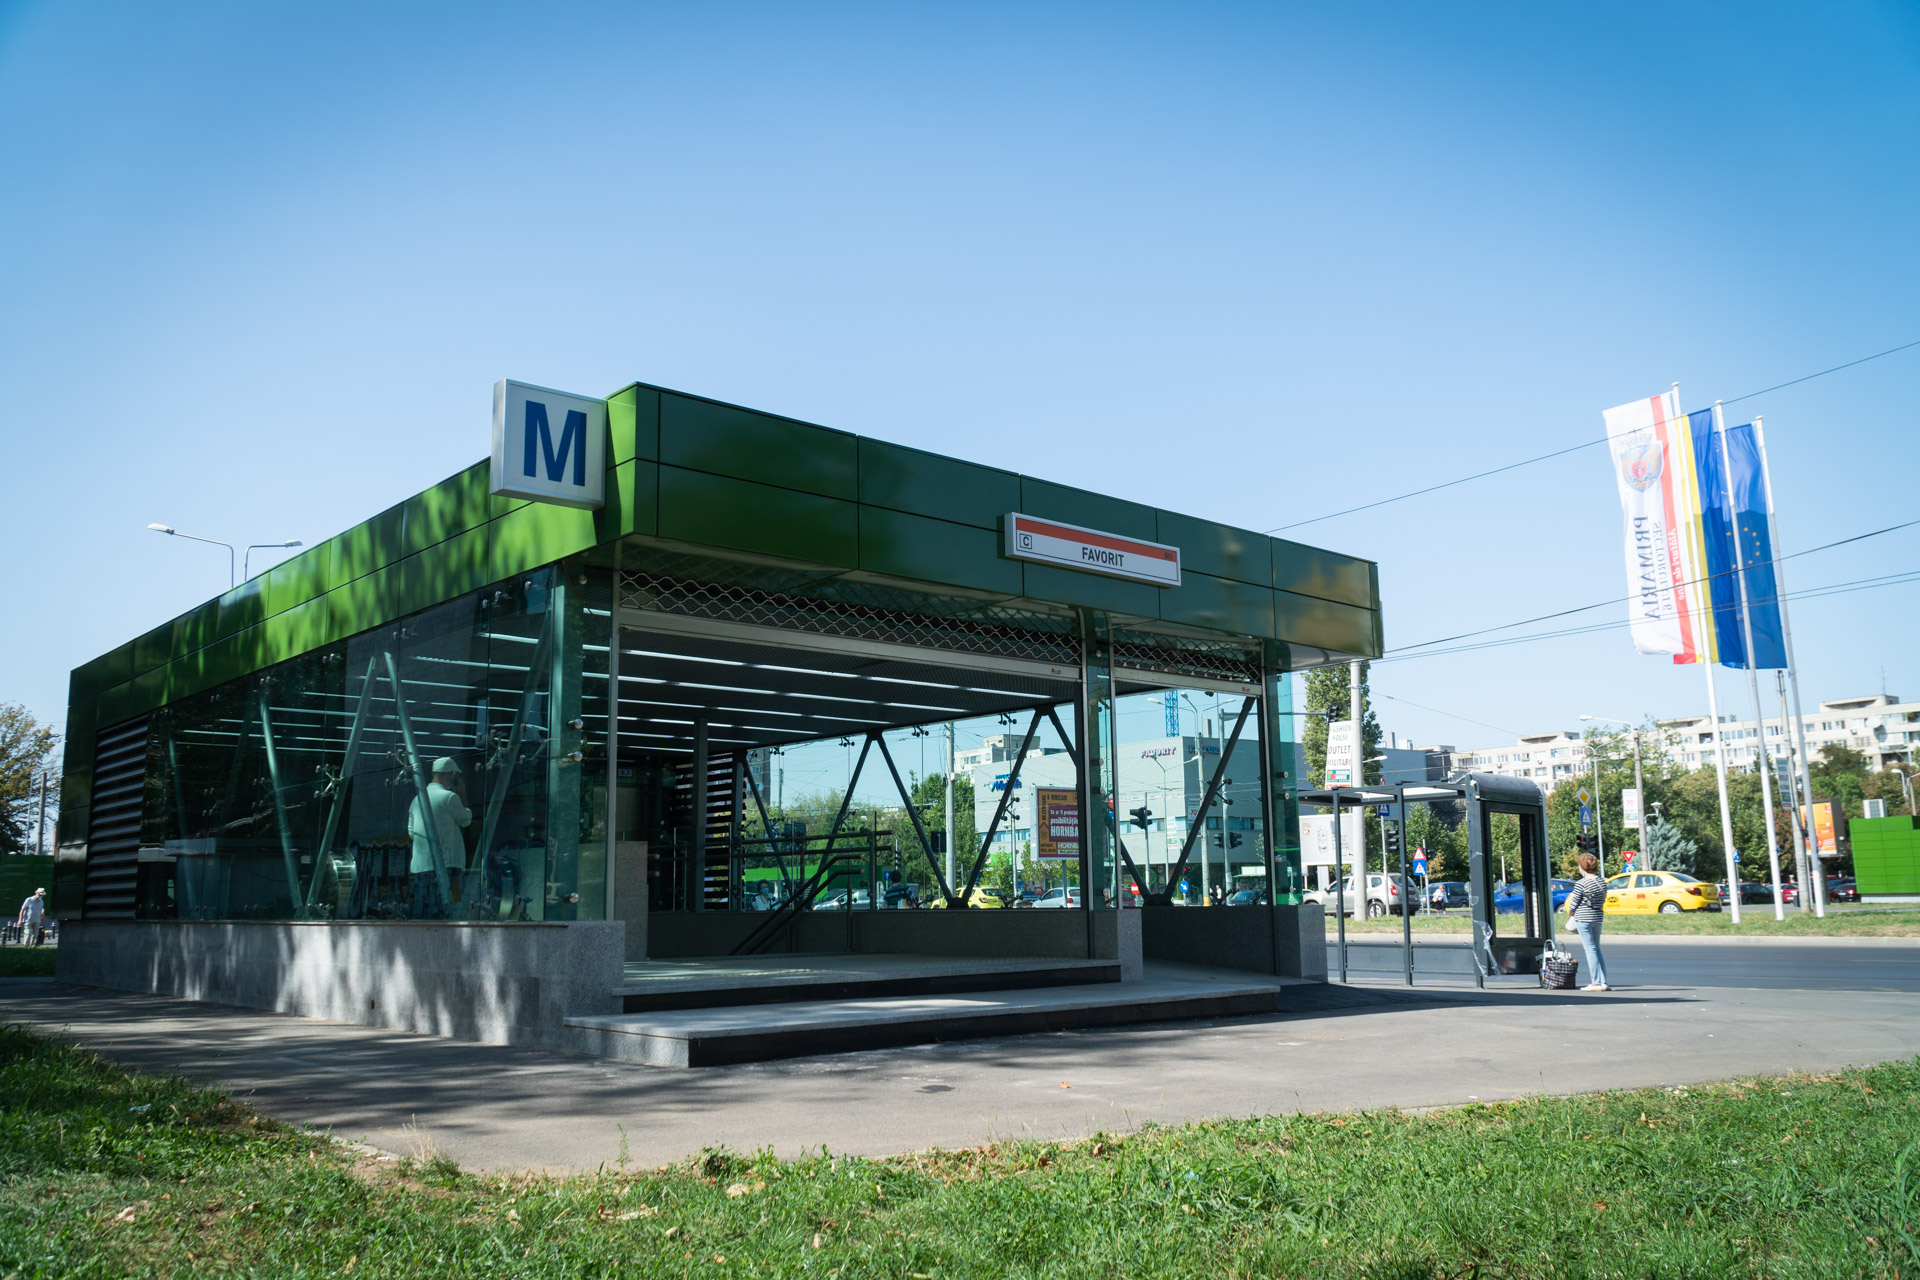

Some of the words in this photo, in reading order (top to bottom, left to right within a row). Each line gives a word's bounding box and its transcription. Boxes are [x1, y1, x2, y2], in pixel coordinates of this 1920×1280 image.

[524, 400, 587, 487] M
[1023, 536, 1030, 547] C
[1081, 546, 1125, 567] FAVORIT
[1141, 747, 1176, 758] FAVORIT
[1328, 745, 1351, 754] OUTLET
[1327, 758, 1351, 766] MILITARI
[1051, 826, 1078, 837] HORNBA
